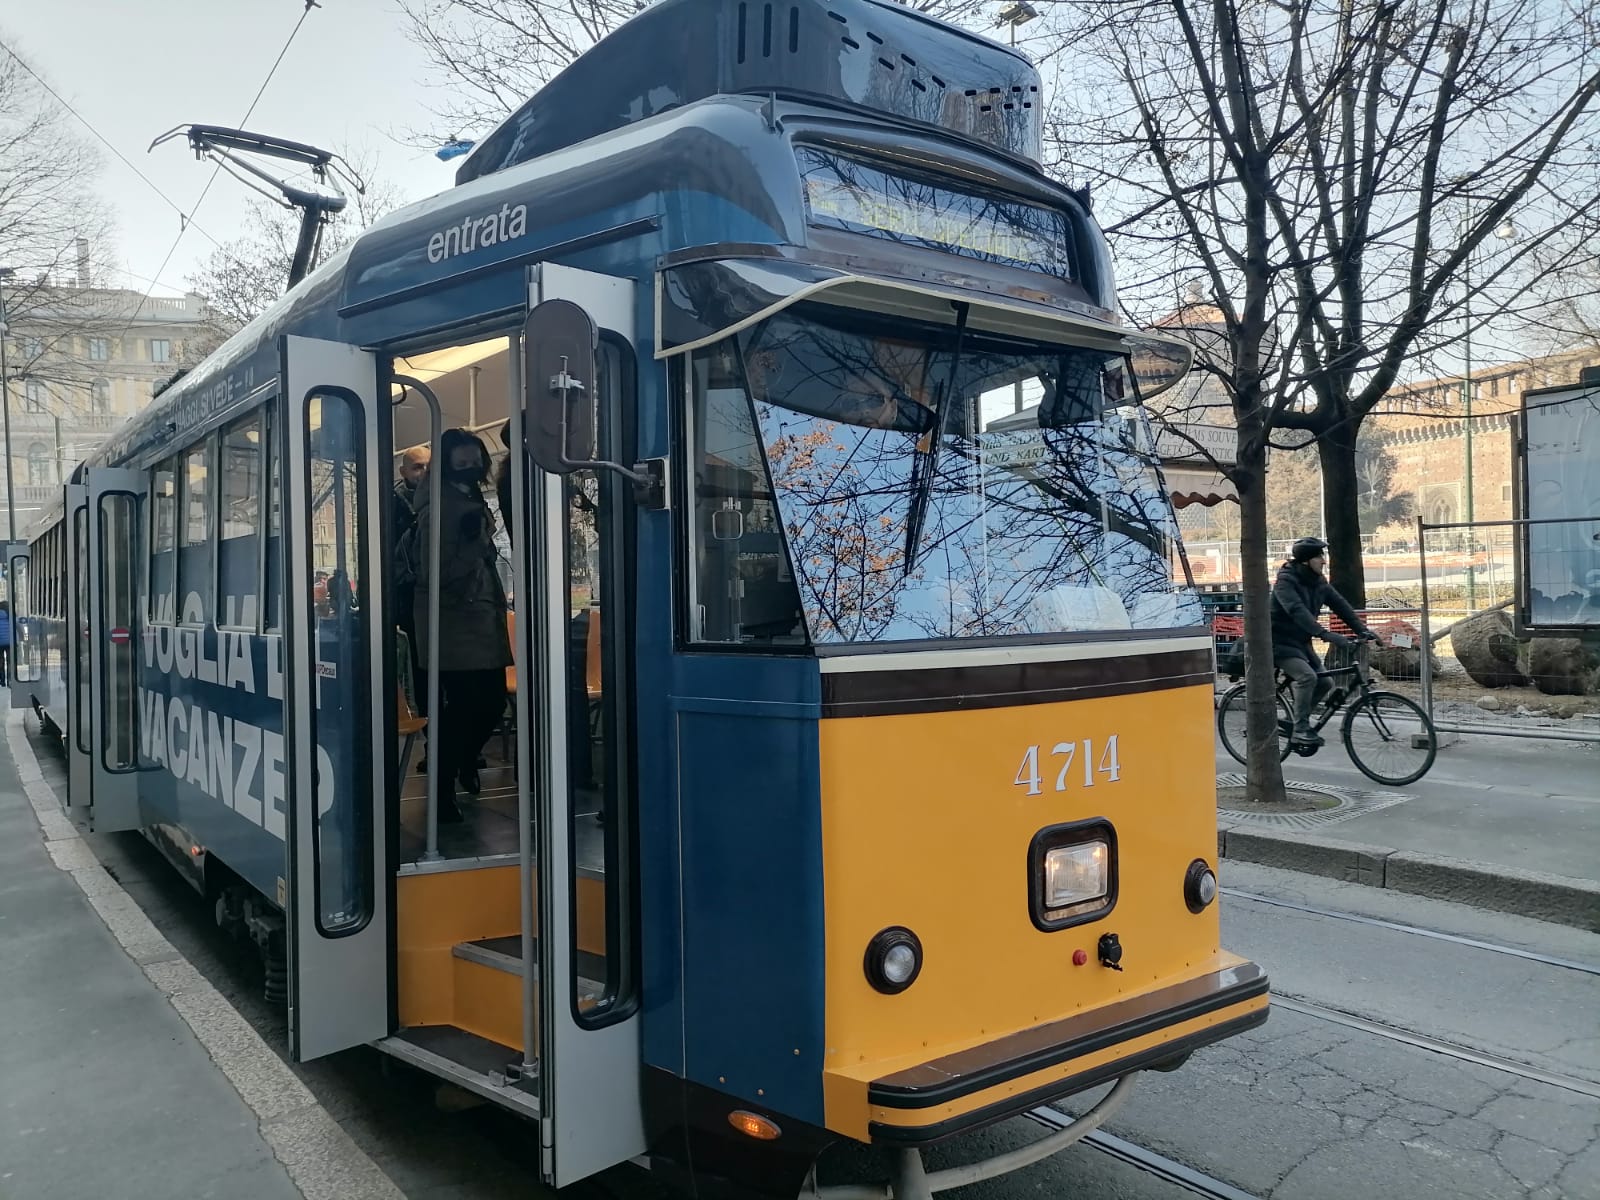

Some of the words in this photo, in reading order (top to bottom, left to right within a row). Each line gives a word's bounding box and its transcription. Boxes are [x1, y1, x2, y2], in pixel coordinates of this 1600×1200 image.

[427, 203, 527, 263] entrata
[141, 591, 255, 694] VOGLIA
[1014, 734, 1120, 796] 4714
